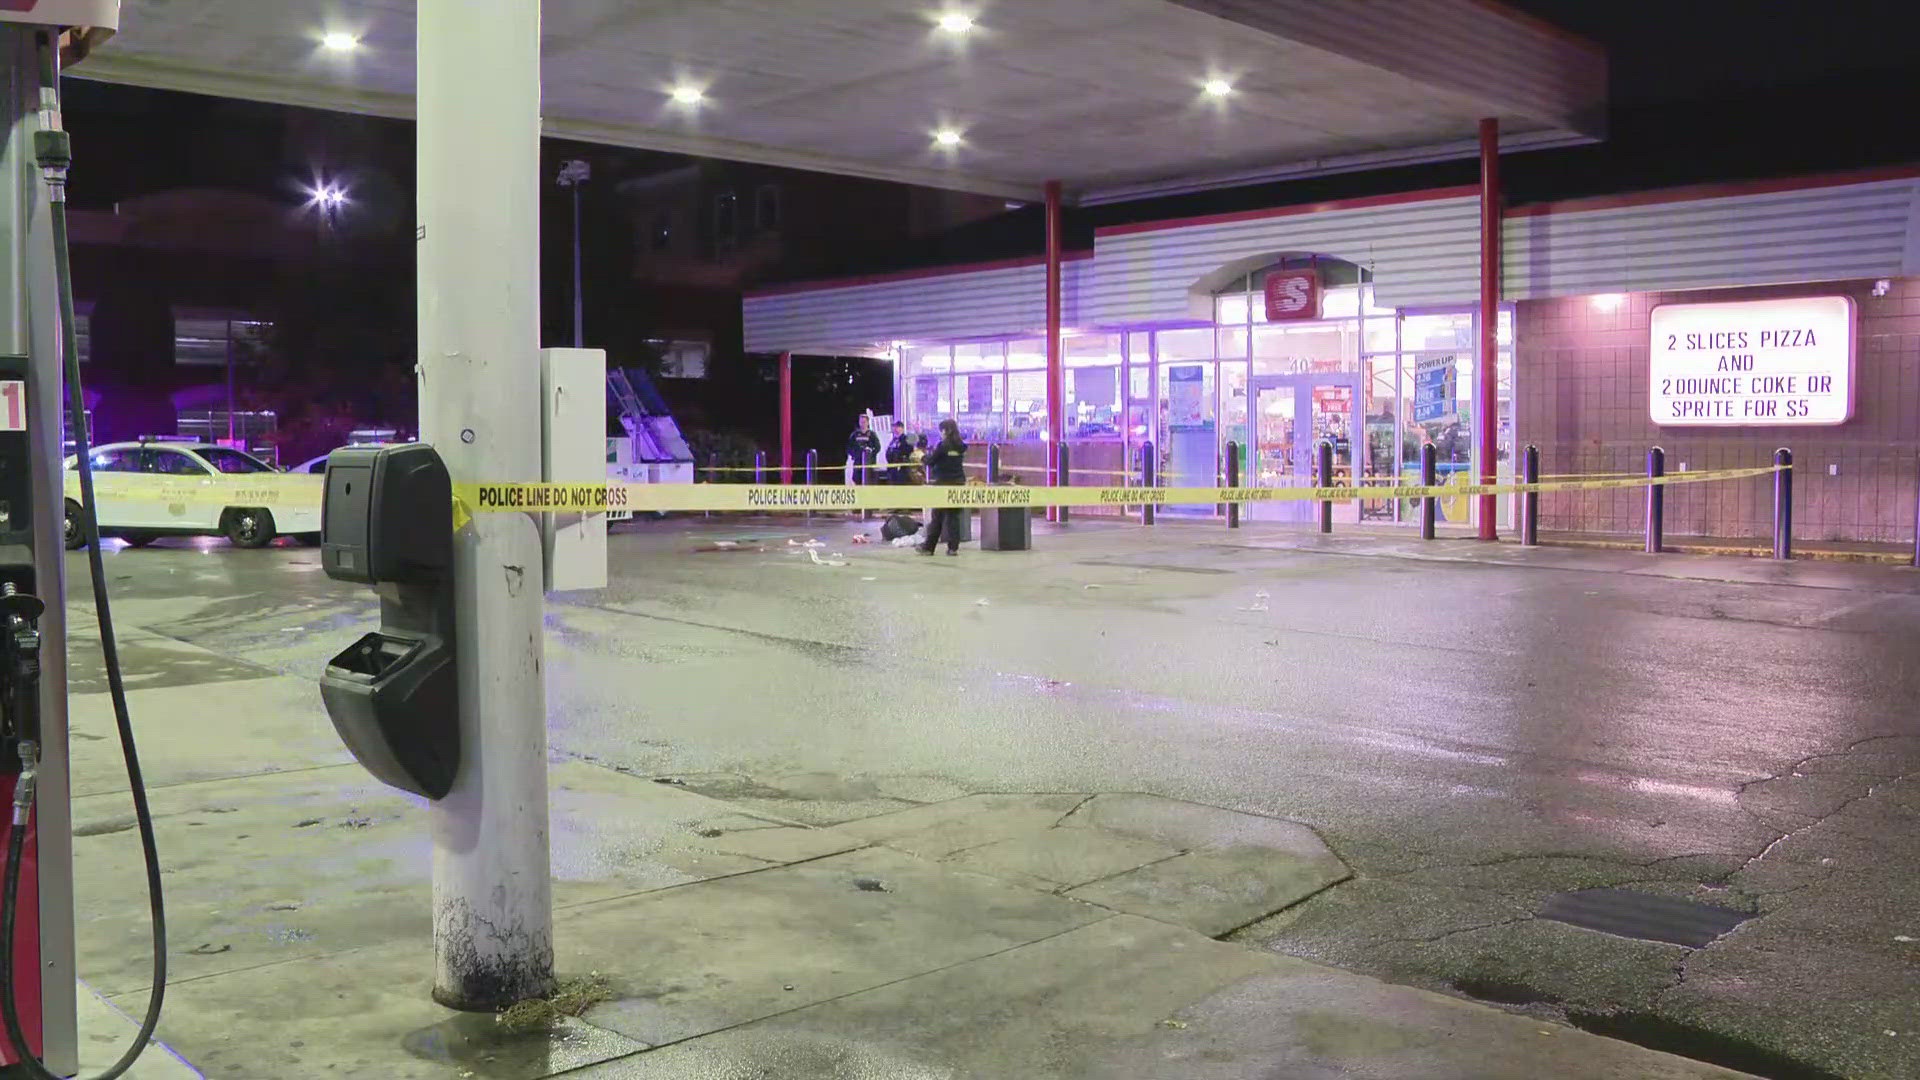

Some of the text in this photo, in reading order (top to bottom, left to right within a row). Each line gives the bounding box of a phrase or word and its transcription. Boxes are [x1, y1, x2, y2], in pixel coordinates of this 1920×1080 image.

[1667, 329, 1817, 351] 2 SLICES PIZZA
[1417, 355, 1454, 370] POWER UP
[1717, 354, 1754, 372] AND
[1751, 376, 1797, 394] COKE
[1808, 375, 1832, 394] OR
[2, 382, 20, 428] 1
[1672, 400, 1734, 418] SPRITE
[1744, 399, 1777, 417] FOR
[480, 487, 627, 506] POLICE LINE DO NOT CROSS
[748, 489, 856, 505] POLICE LINE DO NOT CROSS
[947, 489, 1031, 504] POLICE LINE DO NOT CROSS
